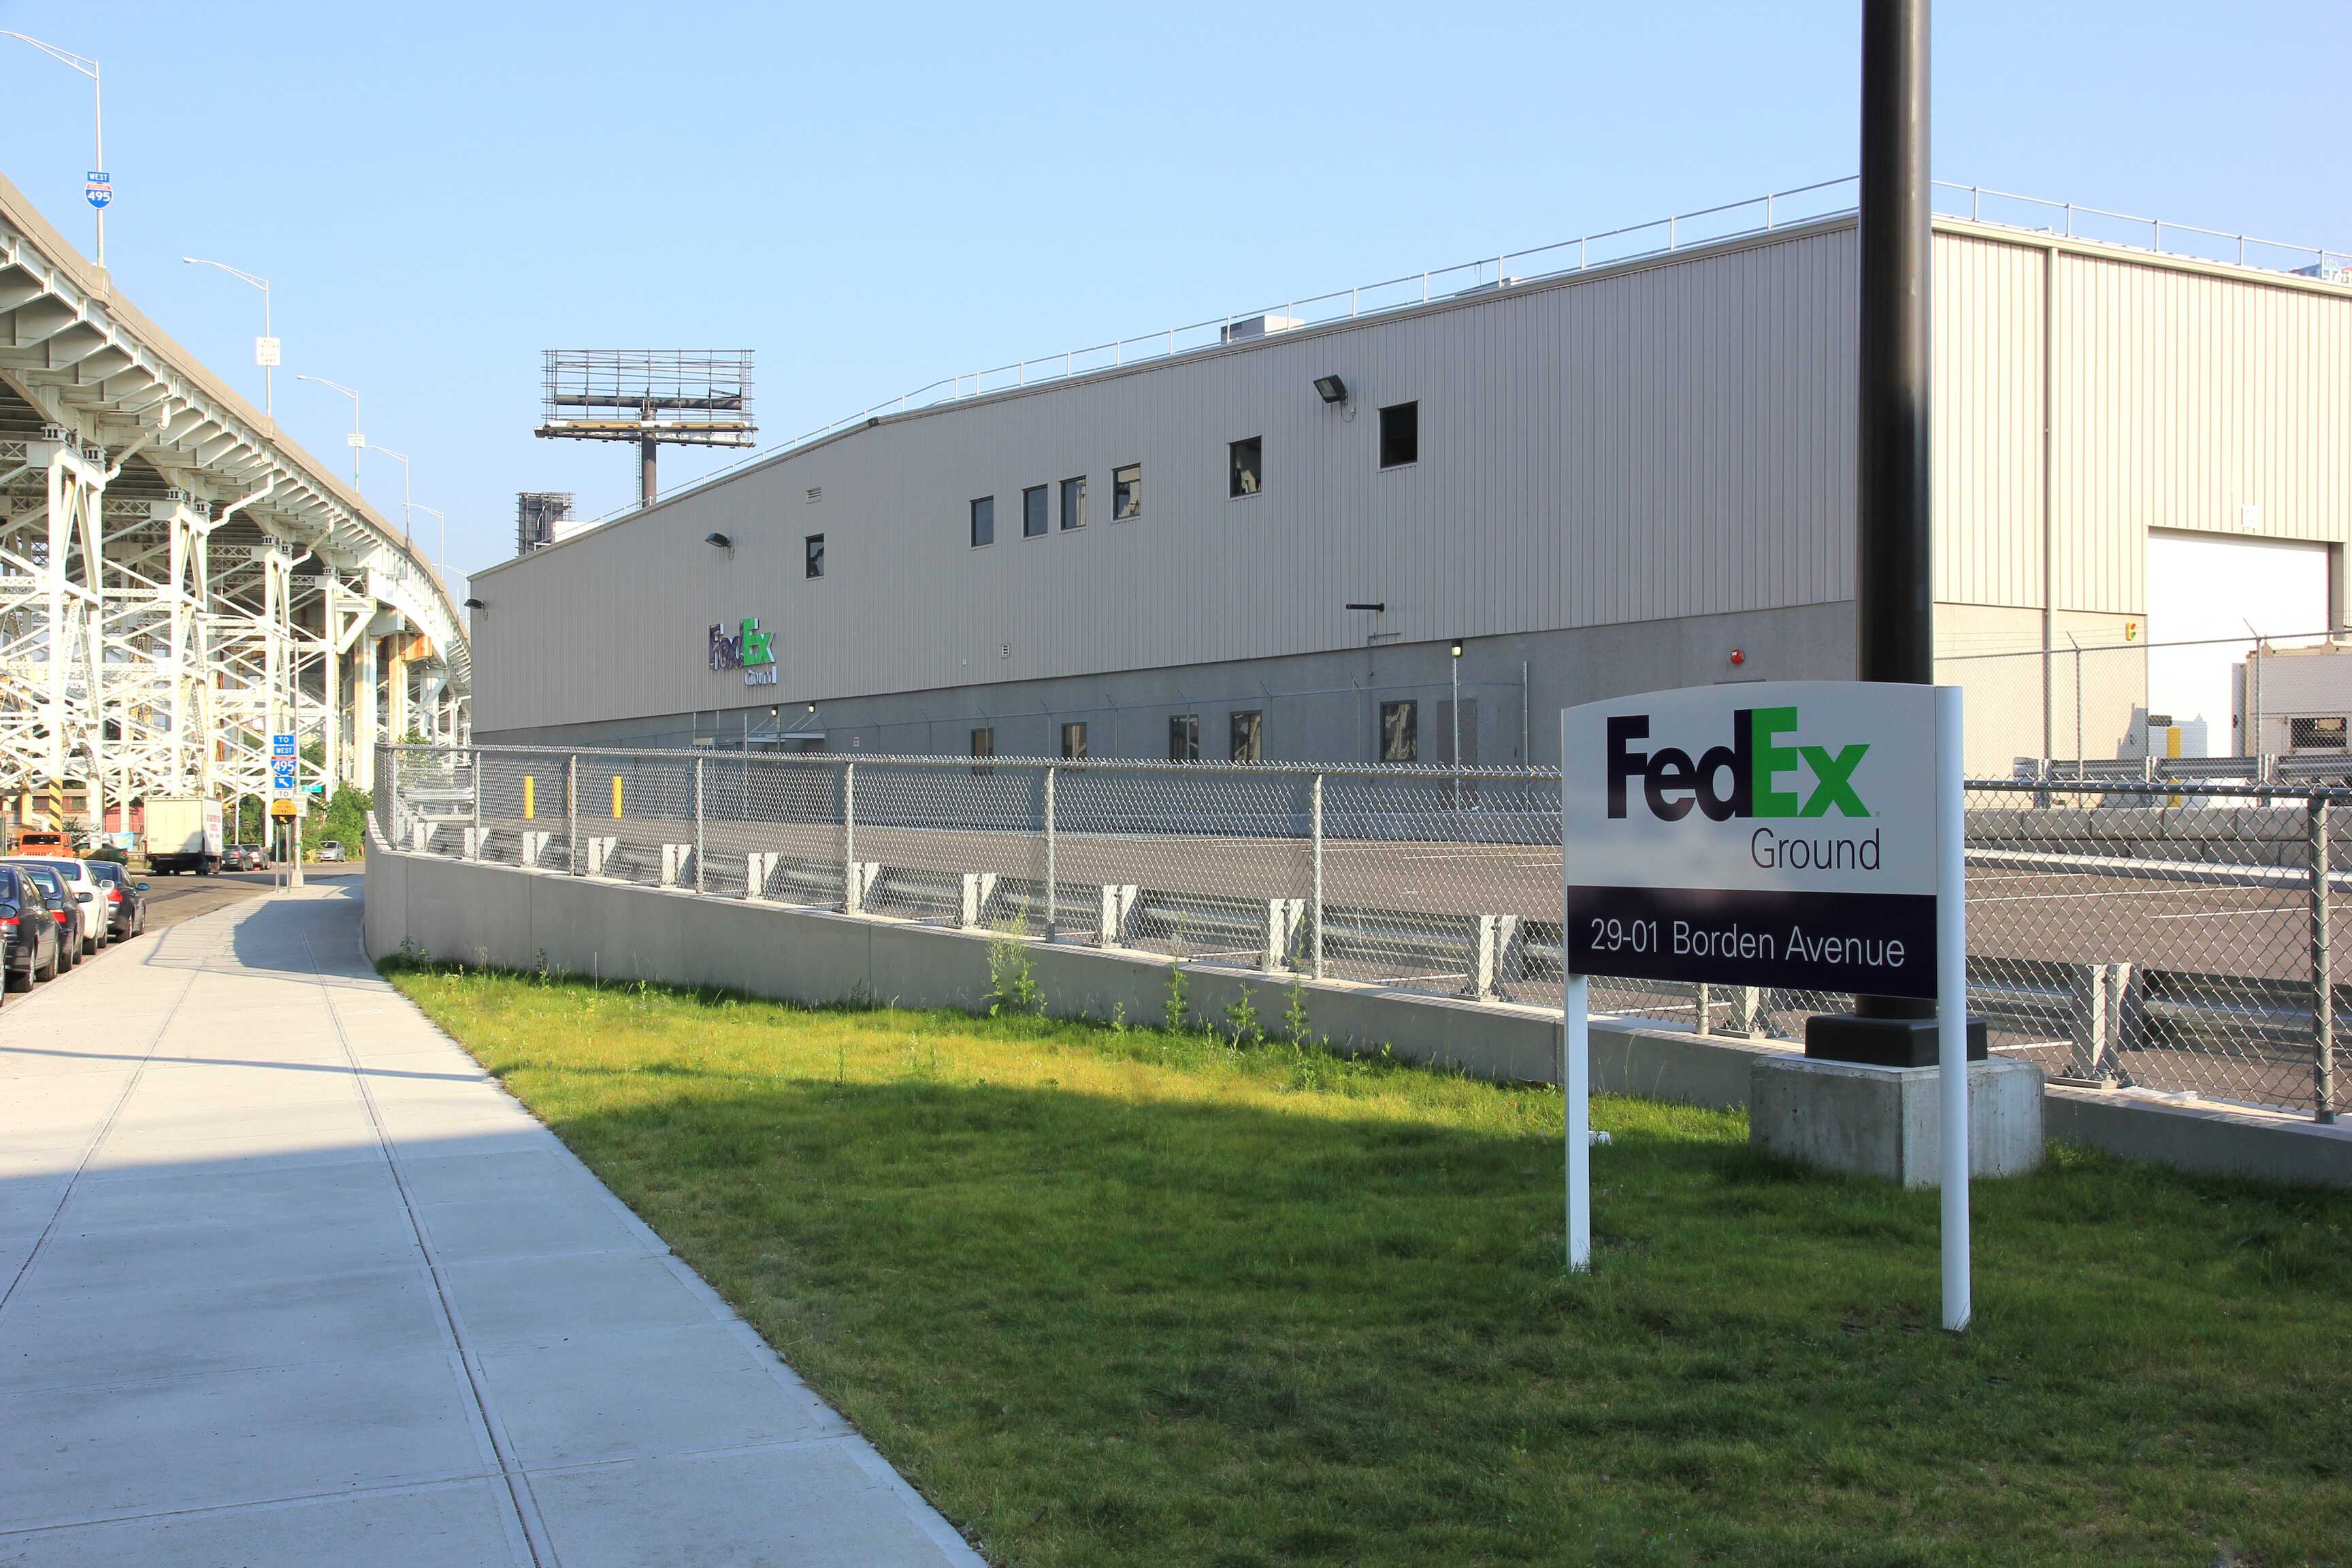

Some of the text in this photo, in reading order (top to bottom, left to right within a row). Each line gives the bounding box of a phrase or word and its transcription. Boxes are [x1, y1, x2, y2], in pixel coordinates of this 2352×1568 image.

[88, 191, 111, 202] 495
[89, 173, 108, 181] WEST
[709, 617, 775, 670] FedEx
[274, 760, 294, 772] 495
[1607, 706, 1872, 821] FedEx
[1751, 827, 1880, 870] Ground
[1590, 917, 1906, 967] 29-01 Borden Avenue
